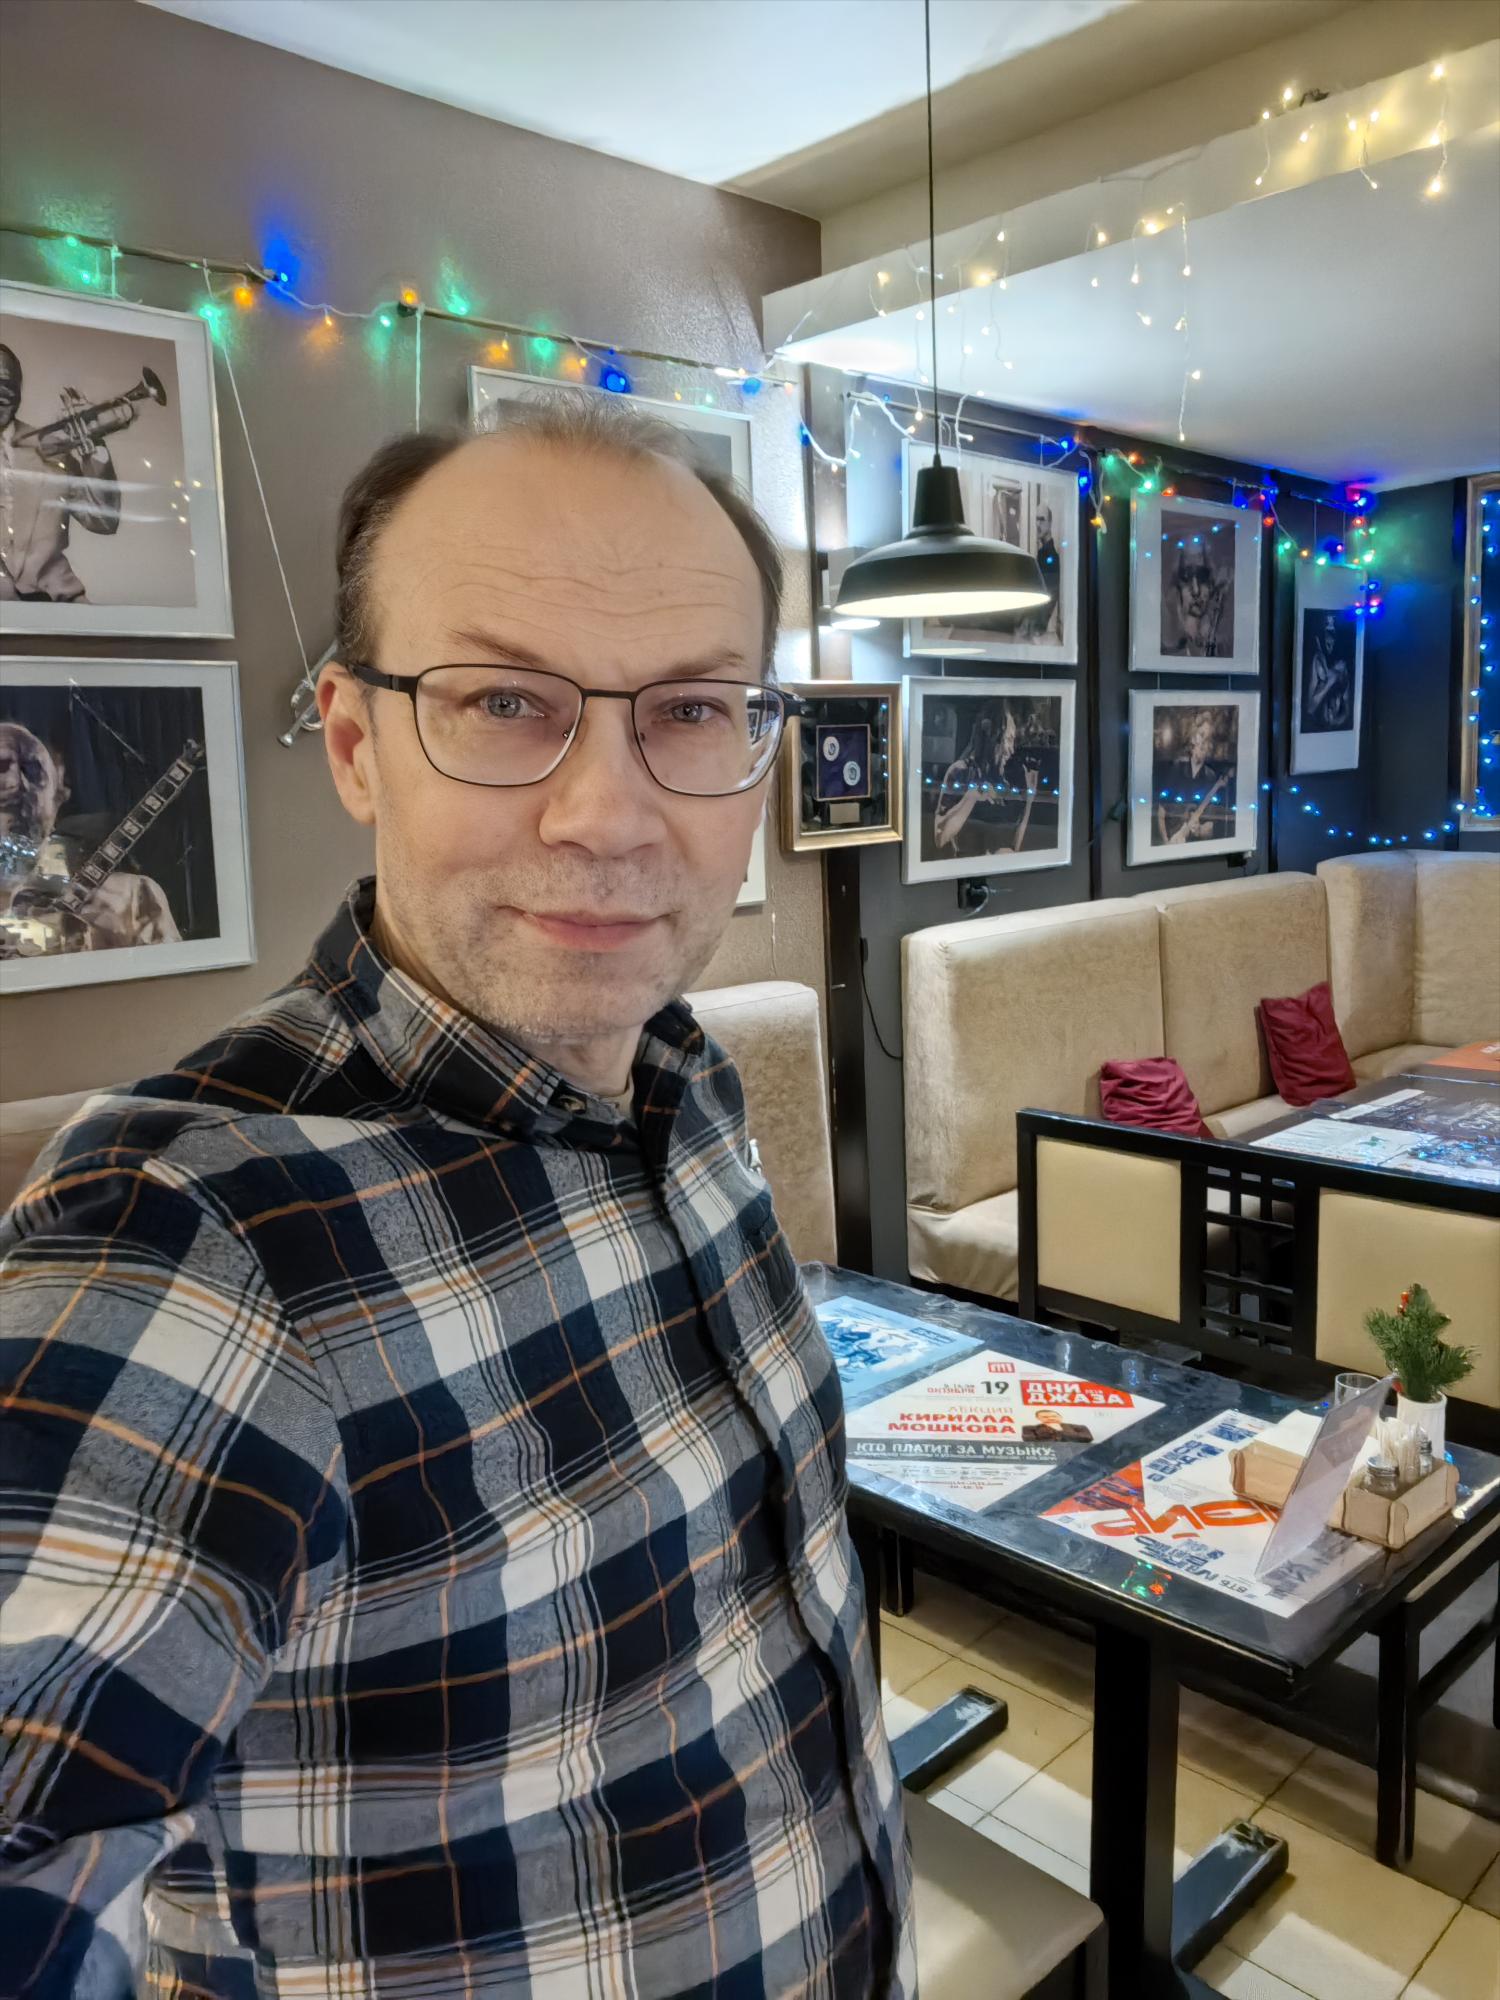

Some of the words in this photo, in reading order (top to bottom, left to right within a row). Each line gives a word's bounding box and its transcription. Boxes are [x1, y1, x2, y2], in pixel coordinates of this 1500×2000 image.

[981, 1380, 1010, 1394] 19
[1026, 1382, 1081, 1395] ДНИ
[1027, 1392, 1125, 1405] ДЖАЗА
[899, 1412, 1015, 1424] КИРИЛЛА
[887, 1422, 1016, 1434] МОШКОВА
[856, 1442, 885, 1453] КТО
[892, 1443, 951, 1455] ПЛАТИТ
[956, 1444, 975, 1456] ЗА
